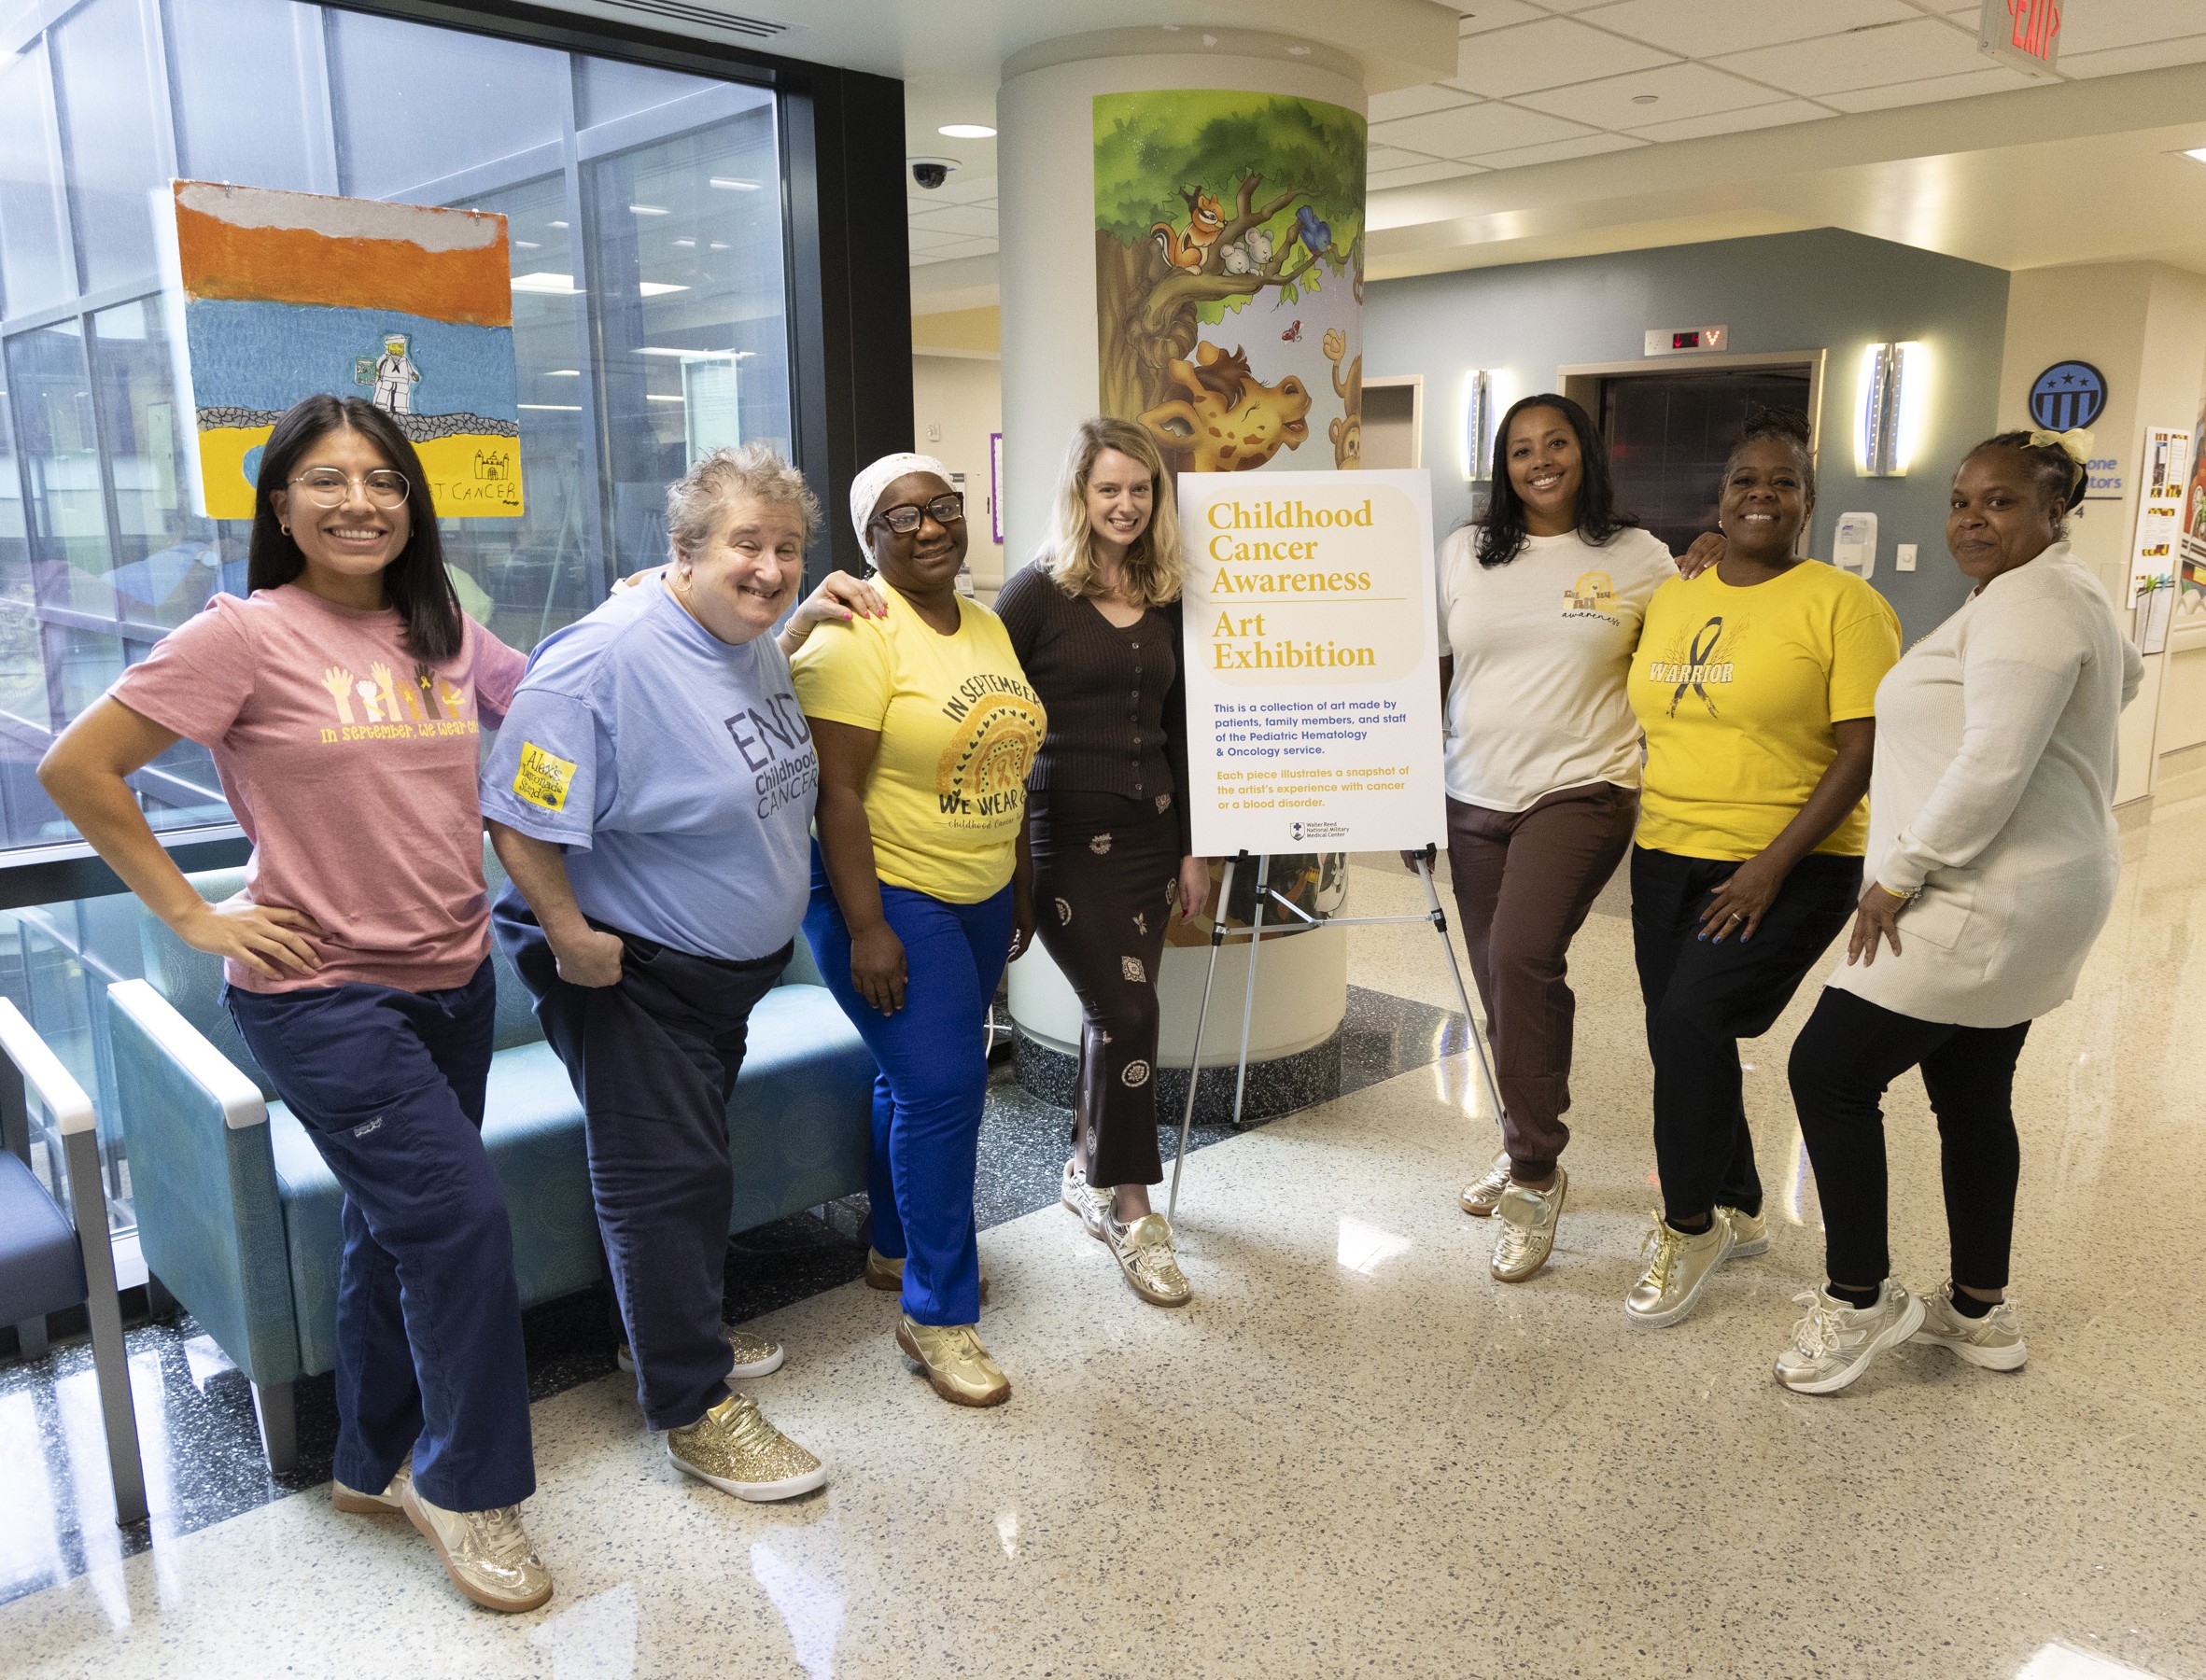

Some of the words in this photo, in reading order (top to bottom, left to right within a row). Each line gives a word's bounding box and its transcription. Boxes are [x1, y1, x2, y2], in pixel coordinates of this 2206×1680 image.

[452, 482, 515, 500] CANCER
[1207, 499, 1374, 529] Childhood
[2074, 505, 2085, 519] 4
[1209, 535, 1318, 562] Cancer
[1210, 567, 1371, 594] Awareness
[1212, 610, 1267, 637] Art
[1561, 611, 1621, 627] awareness
[1213, 640, 1376, 669] Exhibition
[1649, 662, 1734, 684] WARRIOR
[942, 695, 969, 723] IN
[1214, 704, 1235, 713] This
[1238, 703, 1246, 712] is
[1259, 702, 1314, 712] collection
[1316, 701, 1328, 710] of
[1330, 701, 1345, 710] art
[1349, 700, 1381, 709] made
[1384, 699, 1397, 710] by
[1215, 718, 1262, 729] patients,
[1265, 717, 1299, 727] family
[1301, 716, 1355, 725] members,
[1358, 714, 1380, 723] and
[1383, 713, 1407, 723] staff
[320, 728, 339, 743] In
[724, 693, 811, 773] END
[1215, 733, 1226, 742] of
[1229, 733, 1246, 742] the
[1249, 732, 1298, 741] Pediatric
[1301, 730, 1368, 741] Hematology
[1215, 748, 1224, 757] &
[1227, 747, 1280, 758] Oncology
[1284, 746, 1325, 755] service.
[527, 750, 563, 782] Alex's
[755, 744, 817, 796] Childhood
[1216, 770, 1244, 780] Each
[1246, 770, 1278, 781] piece
[1281, 768, 1333, 778] illustrates
[1335, 769, 1343, 777] a
[1346, 766, 1396, 778] snapshot
[1398, 765, 1410, 776] of
[518, 777, 542, 799] Stand
[521, 763, 563, 793] Lemonade
[1217, 785, 1235, 795] the
[1238, 784, 1274, 794] artist's
[1276, 783, 1338, 795] experience
[1341, 782, 1363, 791] with
[1366, 782, 1405, 791] cancer
[757, 767, 818, 819] CANCER
[938, 793, 972, 815] WE
[977, 789, 1018, 816] WEAR
[1217, 802, 1229, 810] or
[1232, 801, 1240, 809] a
[1243, 799, 1275, 809] blood
[1278, 798, 1326, 808] disorder.
